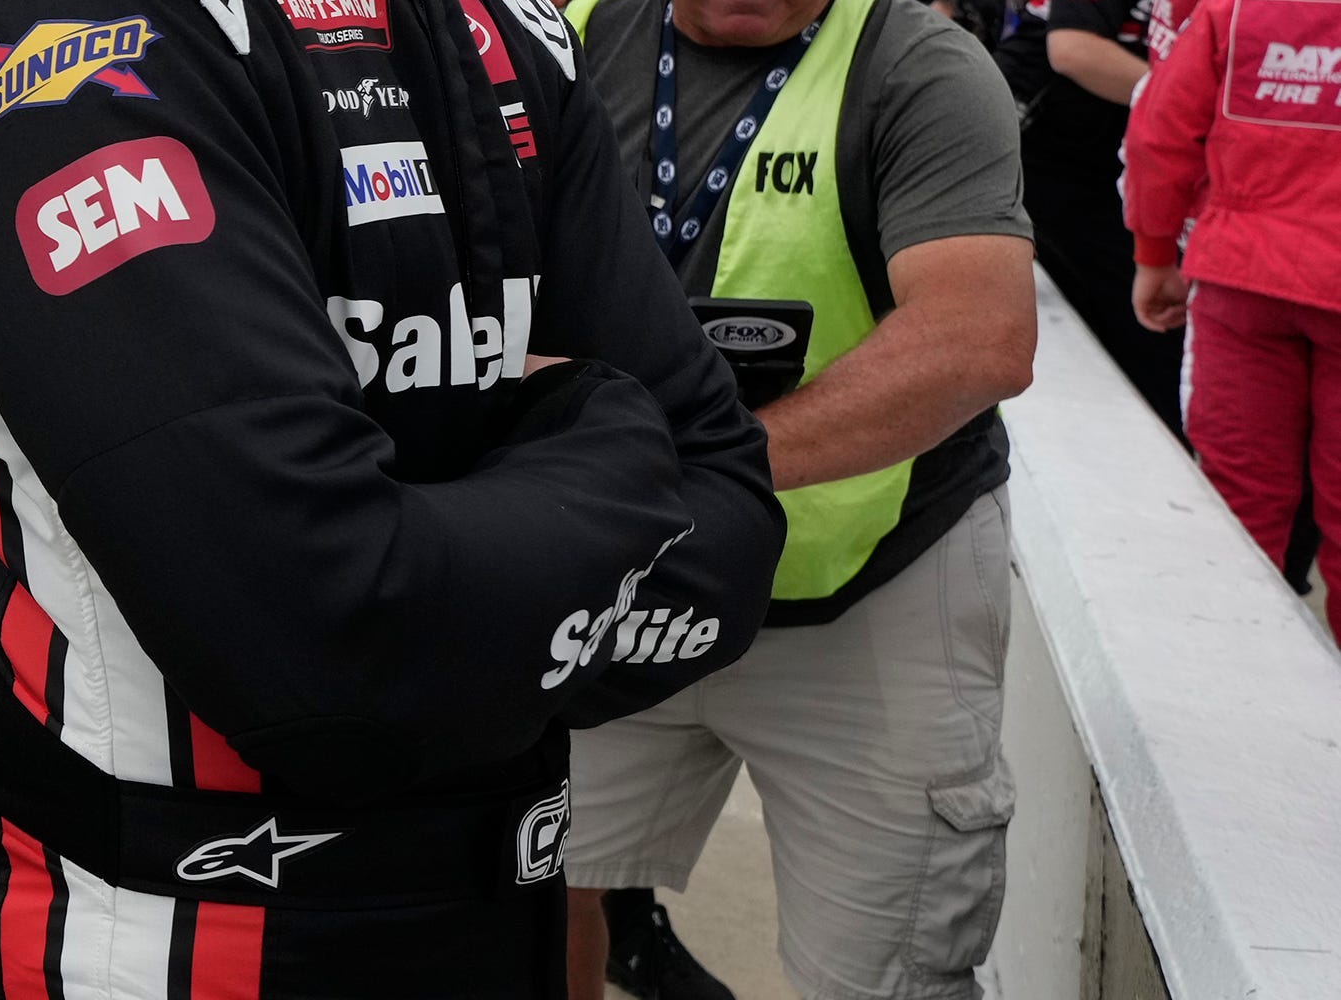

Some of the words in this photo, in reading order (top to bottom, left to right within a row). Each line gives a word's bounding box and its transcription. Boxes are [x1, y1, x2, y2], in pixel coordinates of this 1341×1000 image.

[337, 28, 364, 42] SERIES
[1255, 81, 1322, 105] FIRE
[343, 159, 421, 207] Mobil
[418, 161, 434, 194] 1
[755, 151, 819, 195] FOX
[35, 156, 191, 274] SEM
[725, 326, 767, 338] FOX
